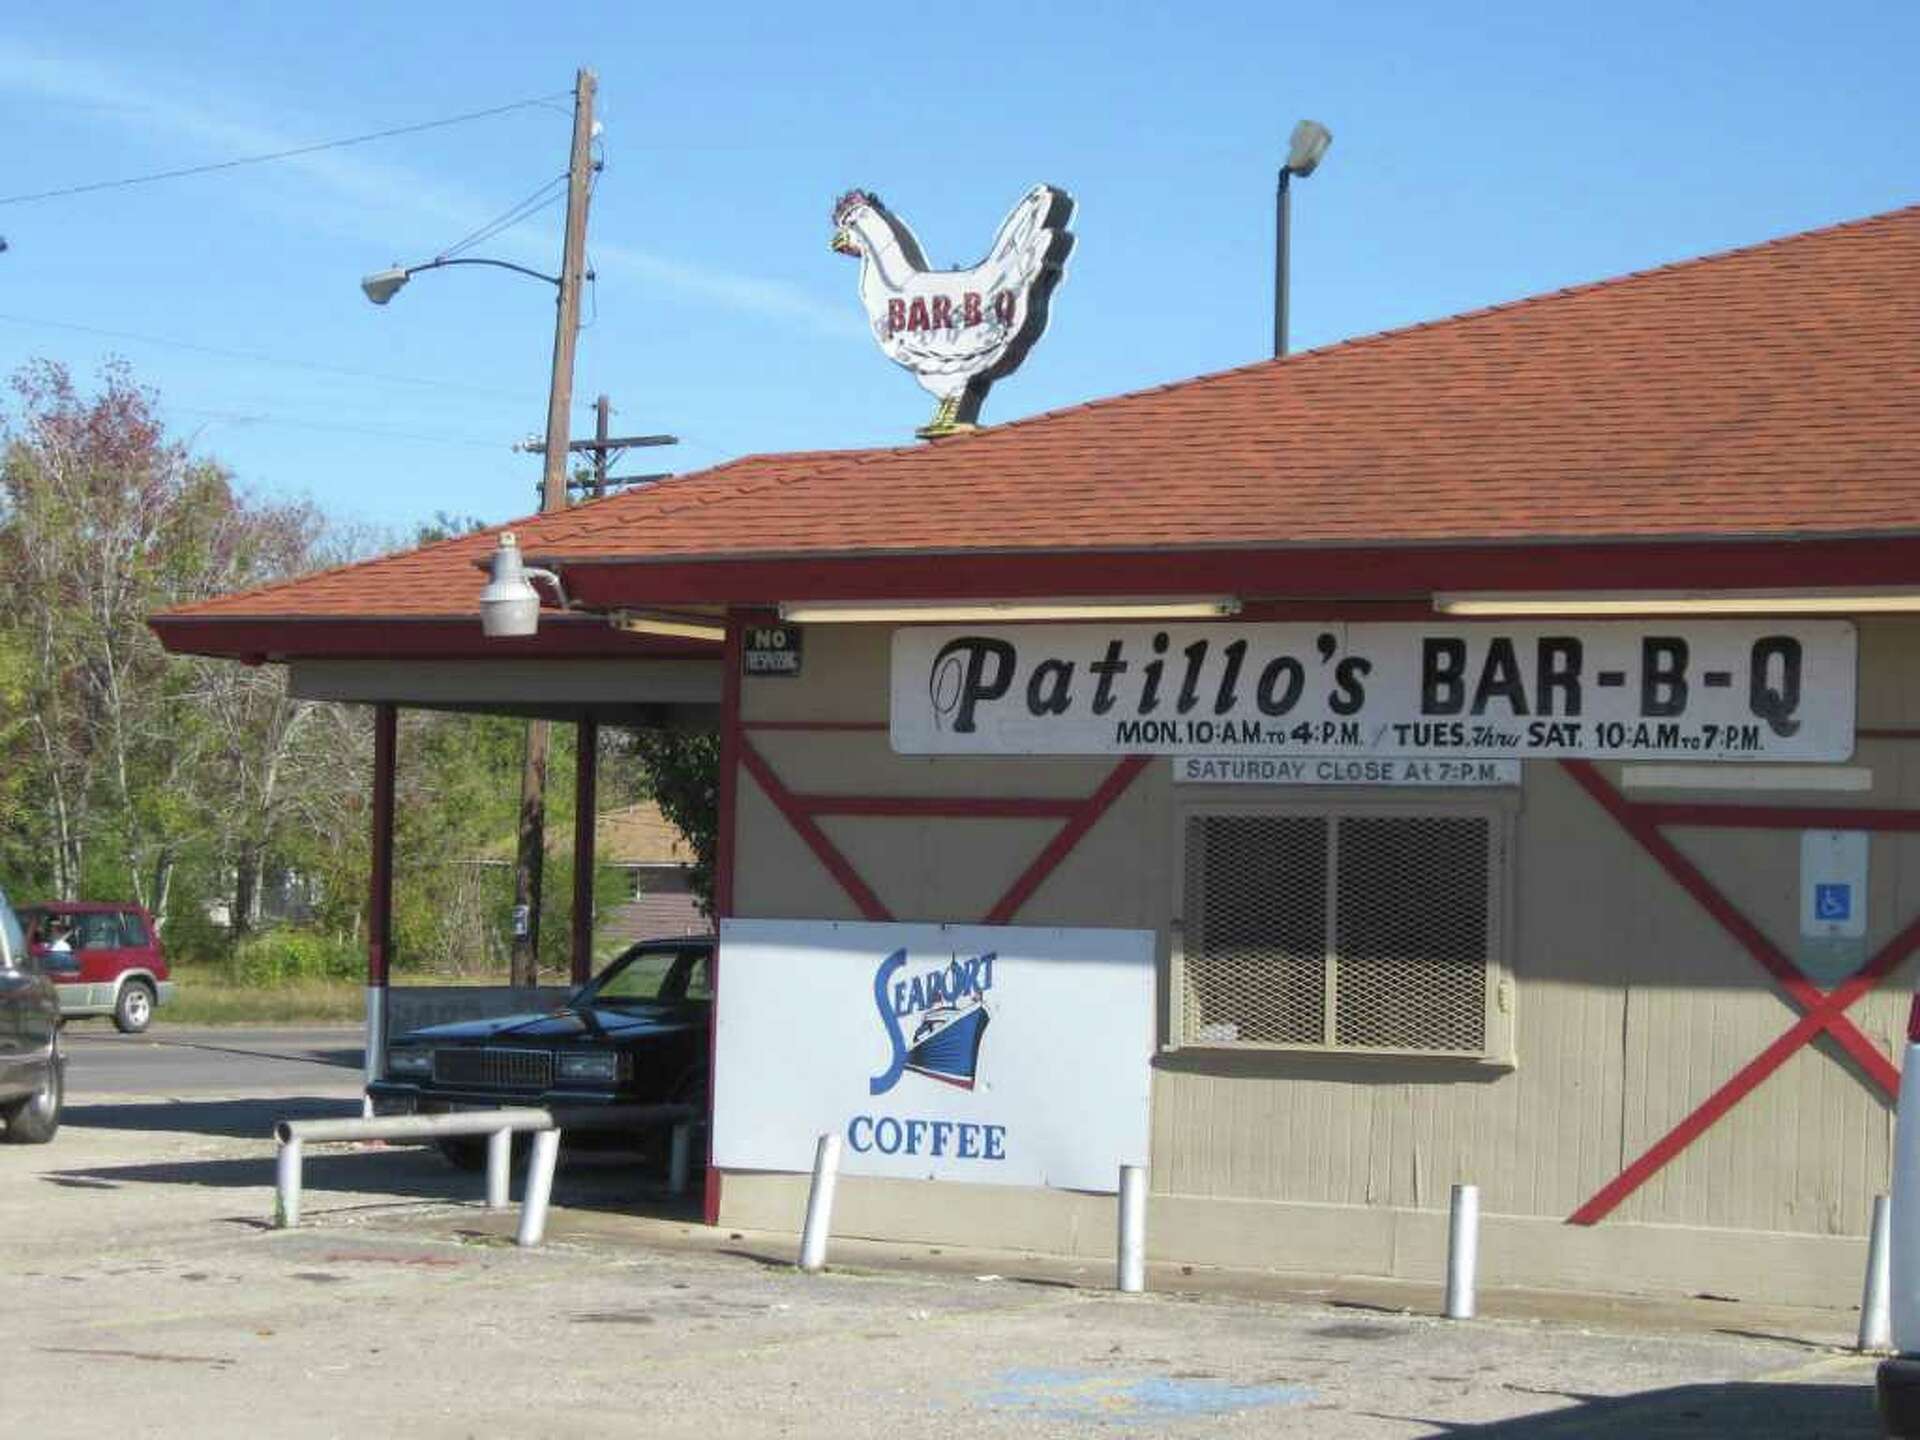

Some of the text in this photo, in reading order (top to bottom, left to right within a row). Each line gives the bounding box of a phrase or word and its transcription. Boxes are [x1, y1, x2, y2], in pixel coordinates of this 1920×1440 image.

[755, 629, 787, 648] NO
[929, 632, 1802, 737] Patillo's BAR-B-Q
[1186, 759, 1304, 780] SATURDAY
[1317, 761, 1393, 781] CLOSE
[869, 948, 998, 1095] SEAPORT
[848, 1115, 1006, 1160] COFFEE
